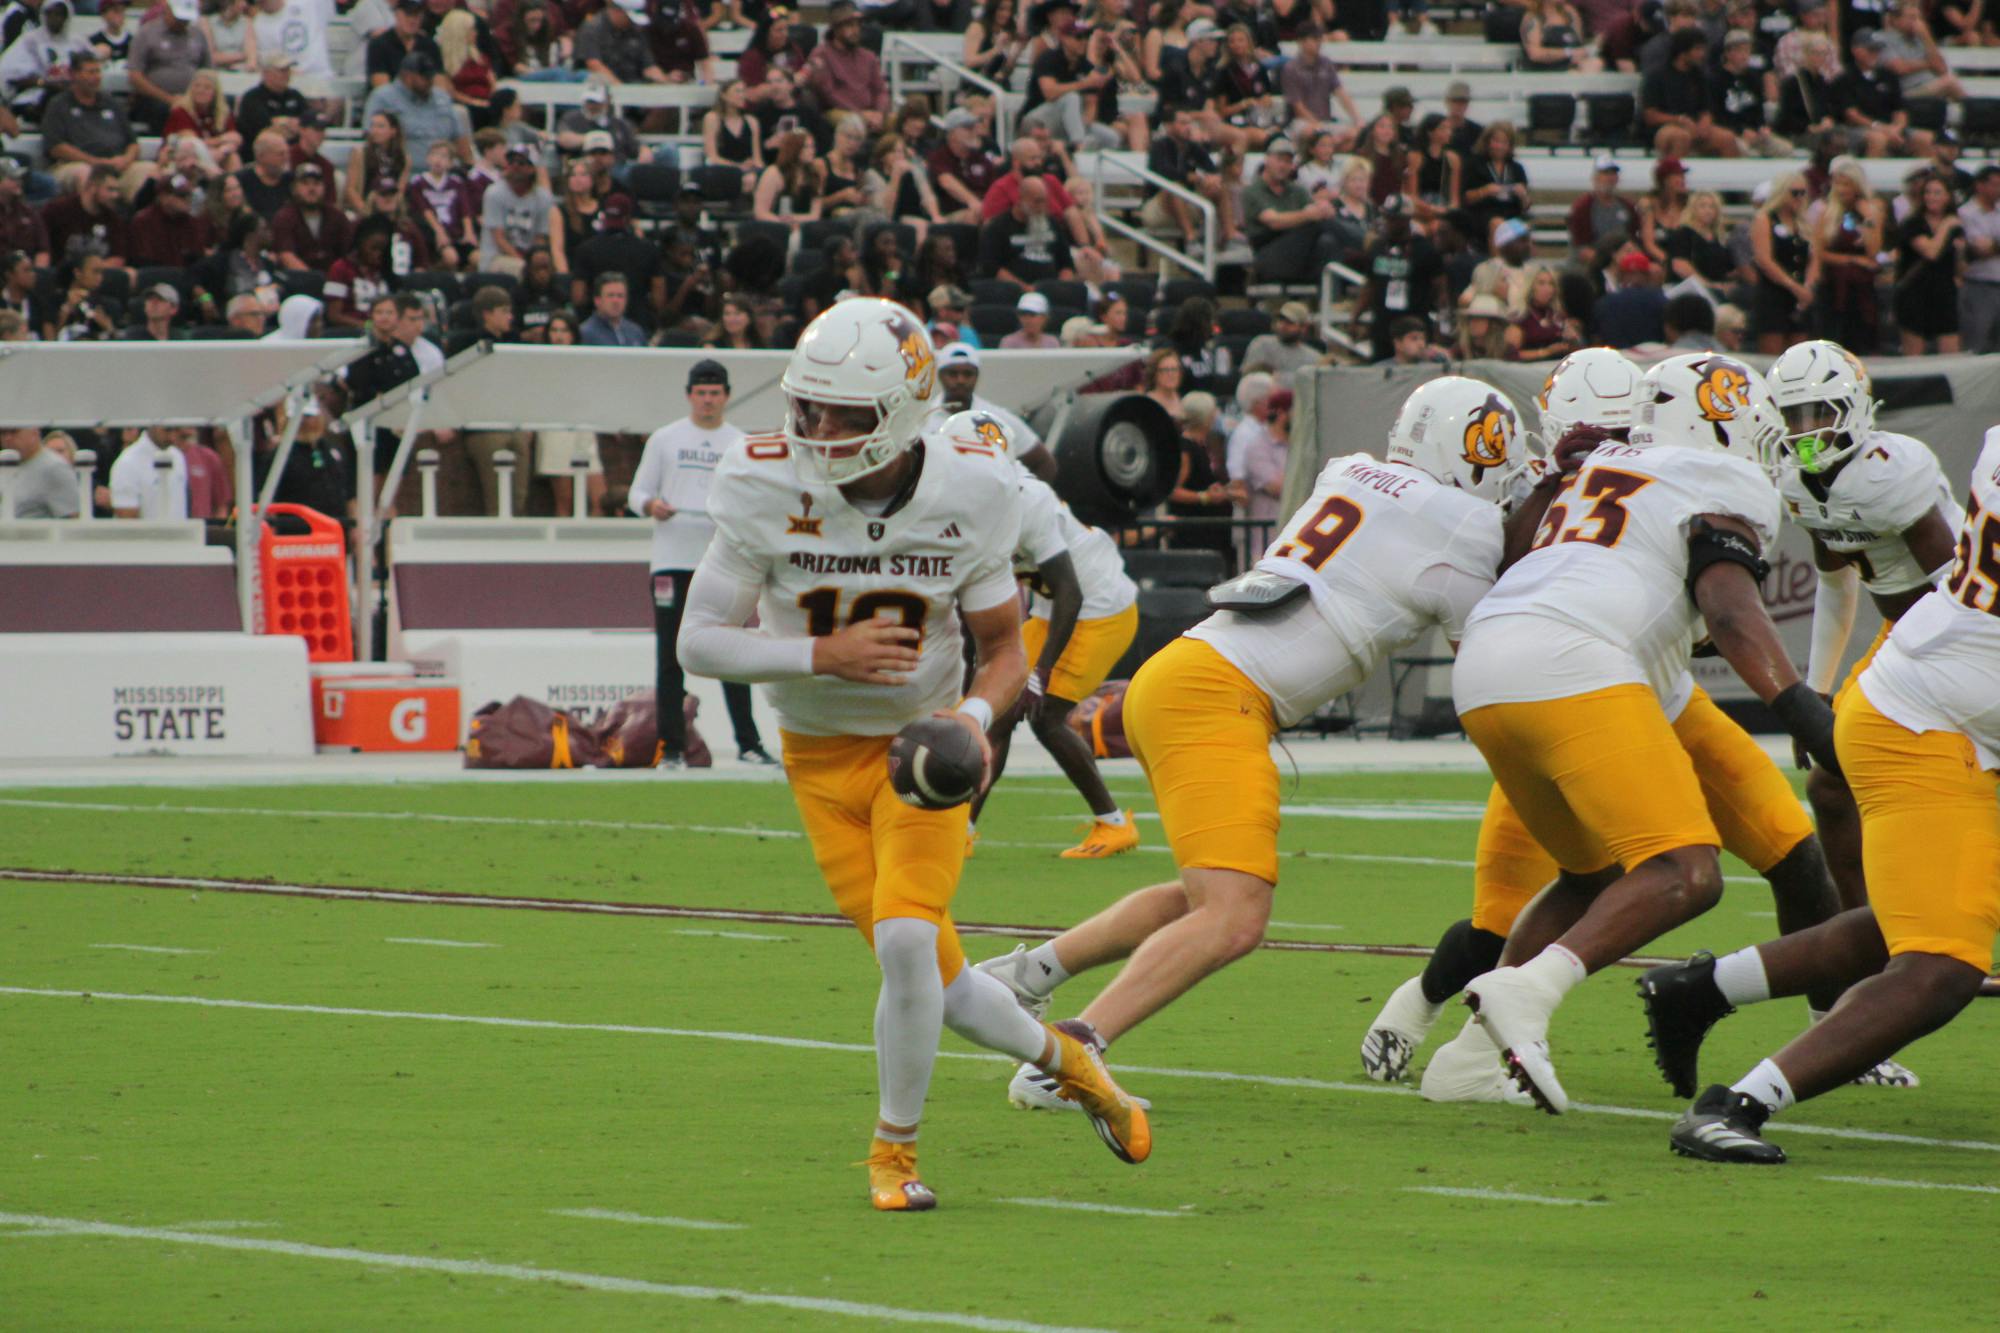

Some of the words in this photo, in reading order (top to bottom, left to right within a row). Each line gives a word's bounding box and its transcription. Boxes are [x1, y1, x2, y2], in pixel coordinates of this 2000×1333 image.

[1864, 446, 1890, 462] 7
[1273, 494, 1365, 573] 9
[788, 551, 882, 575] ARIZONA
[889, 554, 955, 577] STATE
[113, 686, 225, 704] MISSISSIPPI
[115, 708, 225, 740] STATE
[389, 697, 428, 742] G
